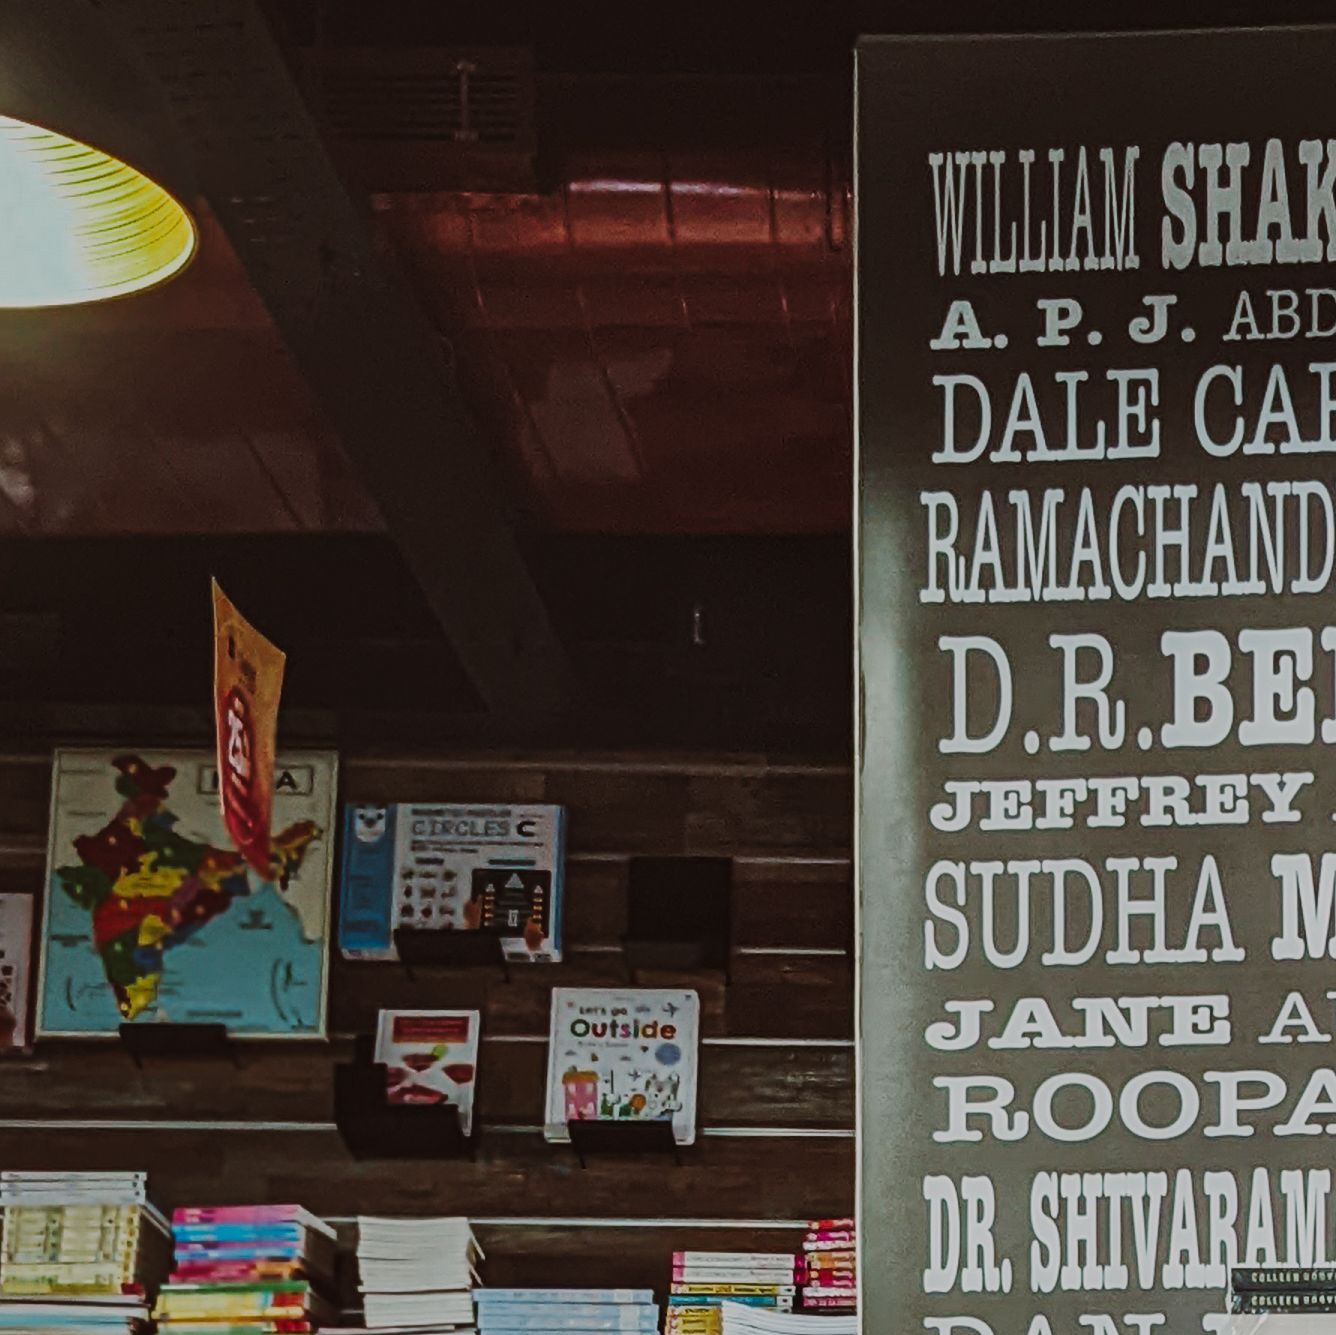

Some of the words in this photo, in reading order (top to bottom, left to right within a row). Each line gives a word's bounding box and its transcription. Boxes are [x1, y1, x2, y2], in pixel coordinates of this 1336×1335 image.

[929, 146, 1140, 275] WILLIAM
[930, 299, 1009, 350] A.
[1037, 298, 1103, 346] P.
[1128, 295, 1196, 344] J.
[932, 368, 1160, 464] DALE
[411, 821, 509, 837] CIRCLES
[930, 772, 1313, 832] JEFFREY
[924, 855, 1244, 971] SUDHA
[570, 1019, 676, 1040] Outside
[924, 995, 1231, 1050] JANE
[923, 1173, 1012, 1293] DR.
[1252, 1270, 1299, 1283] COLLEEN
